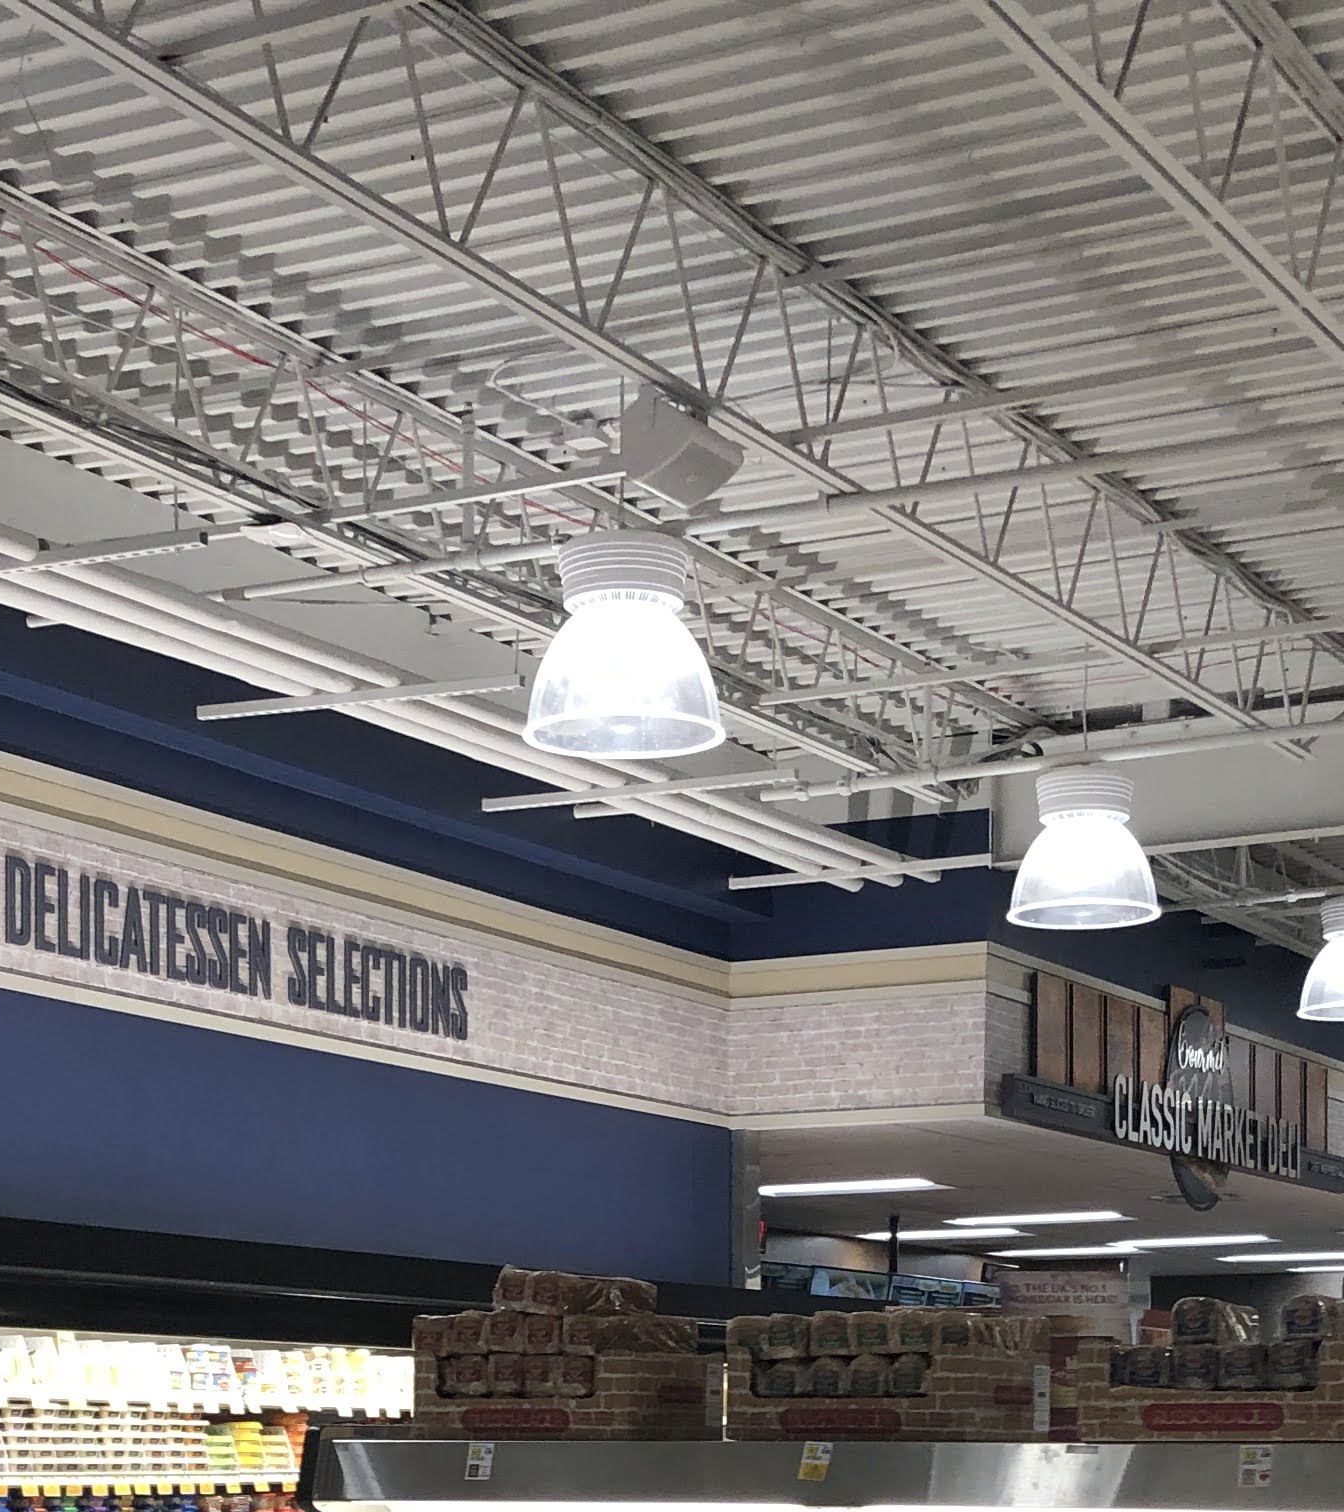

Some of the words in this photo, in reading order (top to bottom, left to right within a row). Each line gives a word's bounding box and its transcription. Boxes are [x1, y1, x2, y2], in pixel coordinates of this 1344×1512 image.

[5, 854, 272, 1000] DELICATESSEN
[287, 922, 469, 1041] SELECTIONS
[1114, 1073, 1194, 1155] CLASSIC
[1197, 1096, 1266, 1172] MARKET
[1267, 1115, 1301, 1180] DELI
